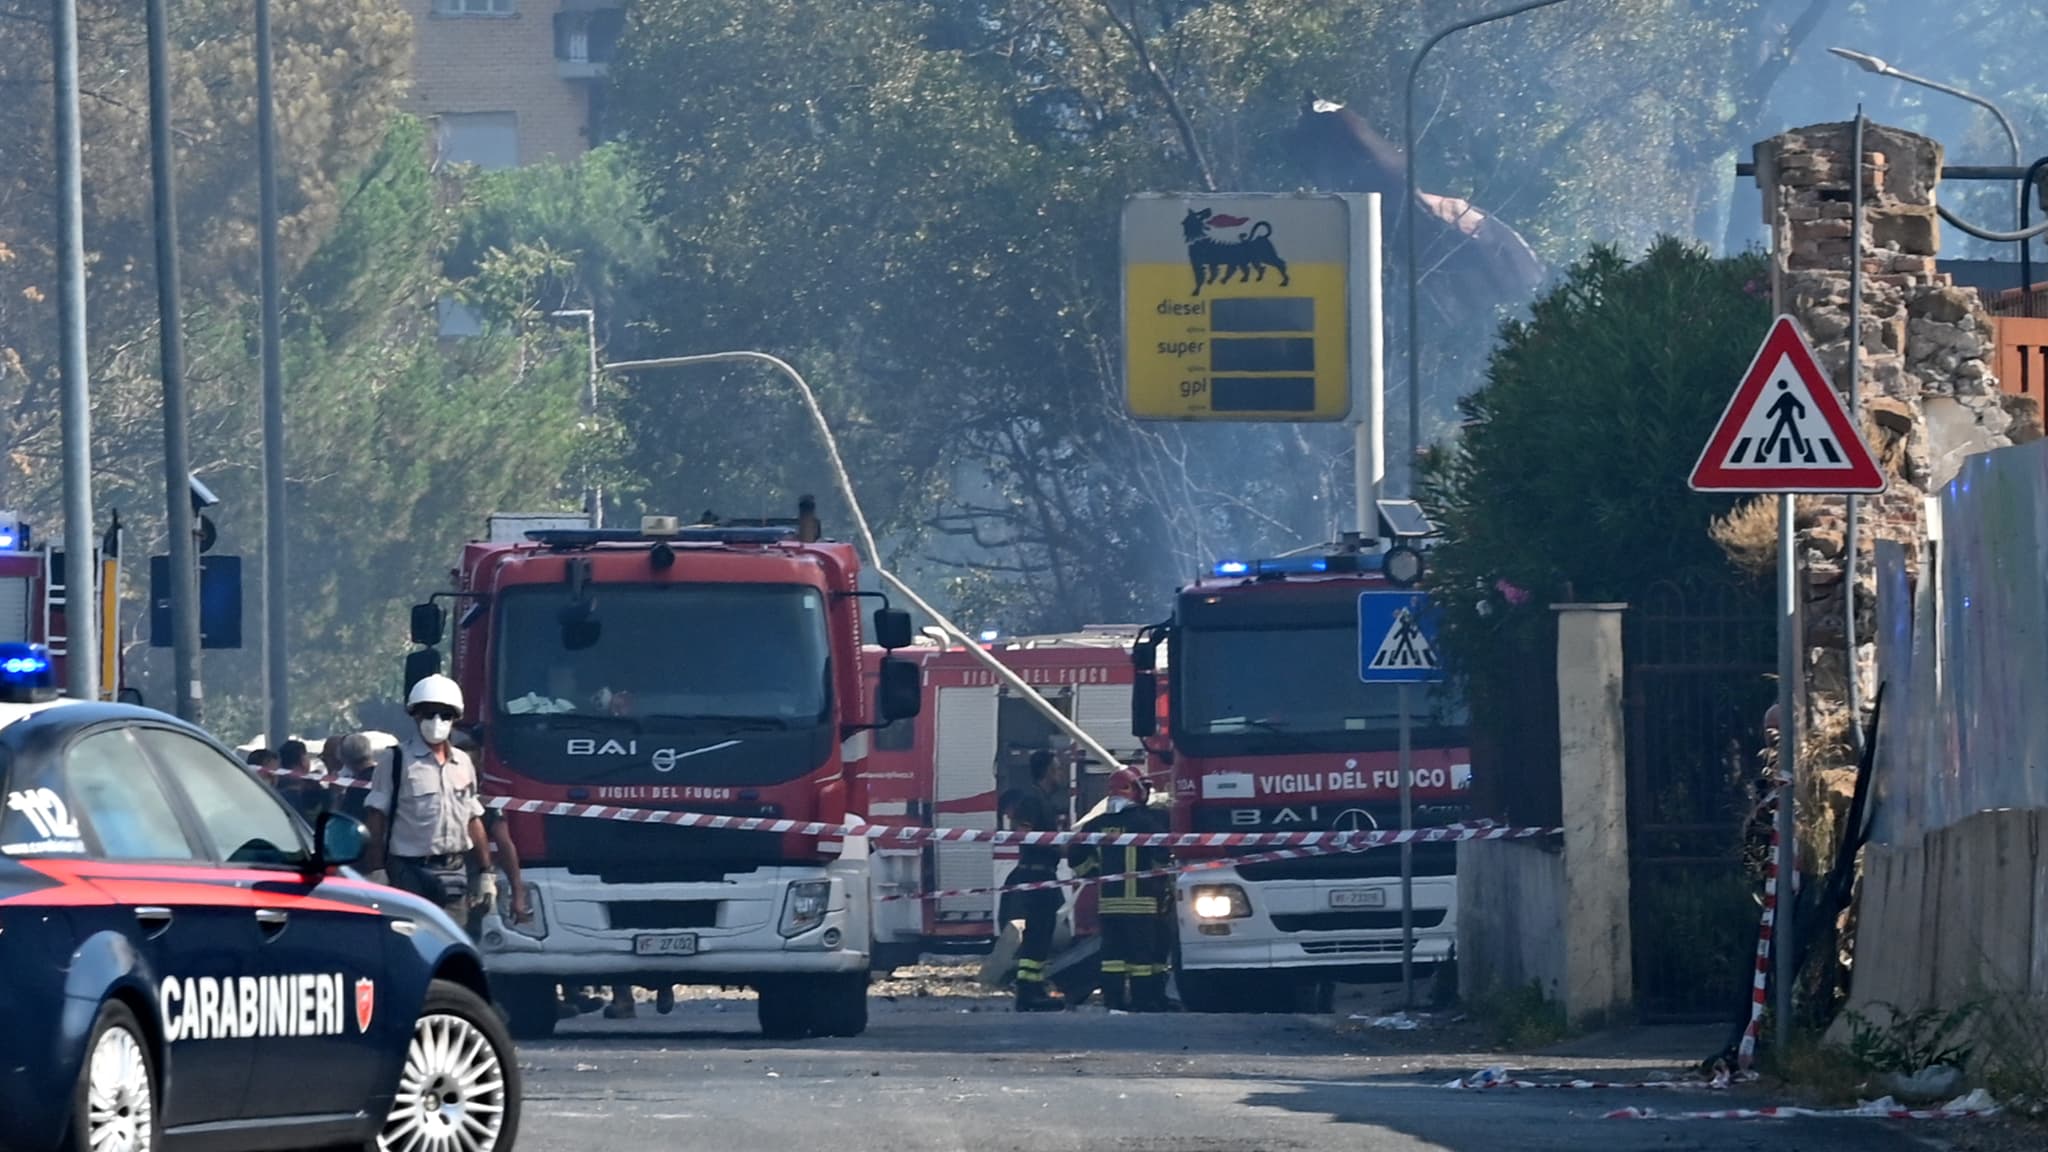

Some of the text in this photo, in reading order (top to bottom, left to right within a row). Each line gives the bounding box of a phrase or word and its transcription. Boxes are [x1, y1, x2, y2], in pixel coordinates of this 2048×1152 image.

[1157, 299, 1205, 315] diesel
[1158, 342, 1204, 357] super
[1180, 378, 1206, 397] gpl
[1060, 668, 1107, 683] FUOCO
[567, 739, 636, 755] BAI
[1260, 774, 1322, 794] VIGILI
[1328, 772, 1366, 790] DEL
[599, 787, 730, 799] VIGILI DEL FUOCO
[7, 787, 80, 838] 112
[1231, 806, 1317, 825] BAI
[160, 972, 344, 1042] CARABINIERI
